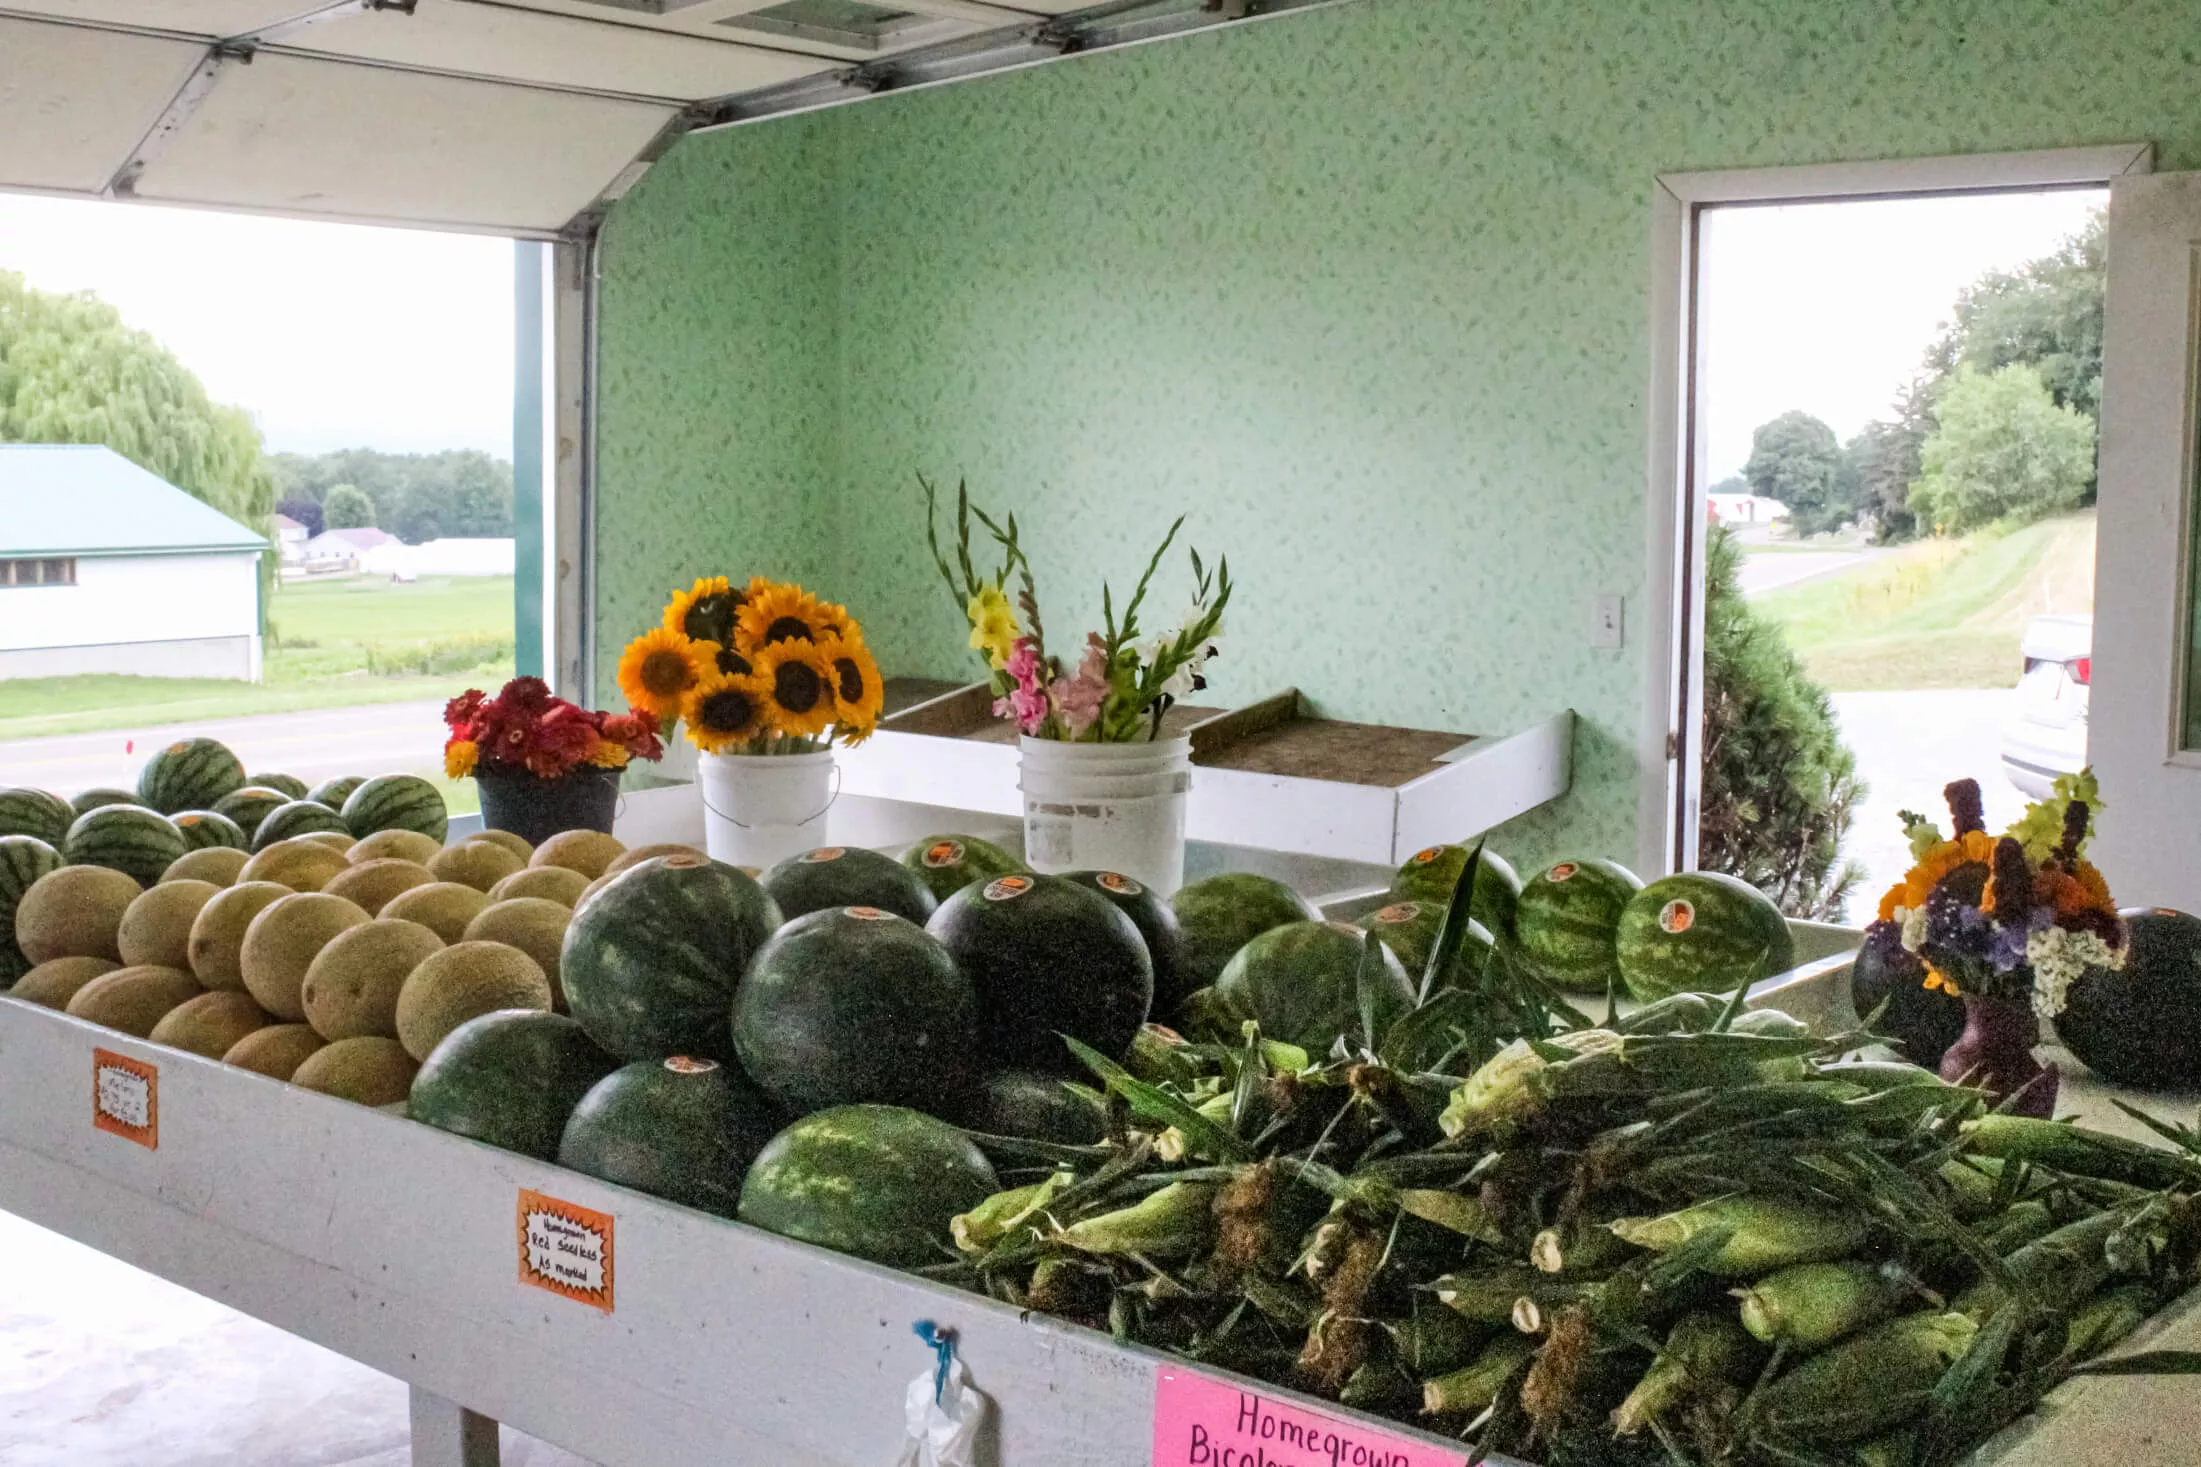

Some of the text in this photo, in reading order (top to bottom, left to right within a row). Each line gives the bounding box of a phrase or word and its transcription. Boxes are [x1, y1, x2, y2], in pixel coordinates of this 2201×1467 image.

[531, 1232, 550, 1250] Red
[538, 1254, 551, 1270] As
[1236, 1392, 1409, 1467] Homegrown
[1189, 1424, 1295, 1467] Bicol
